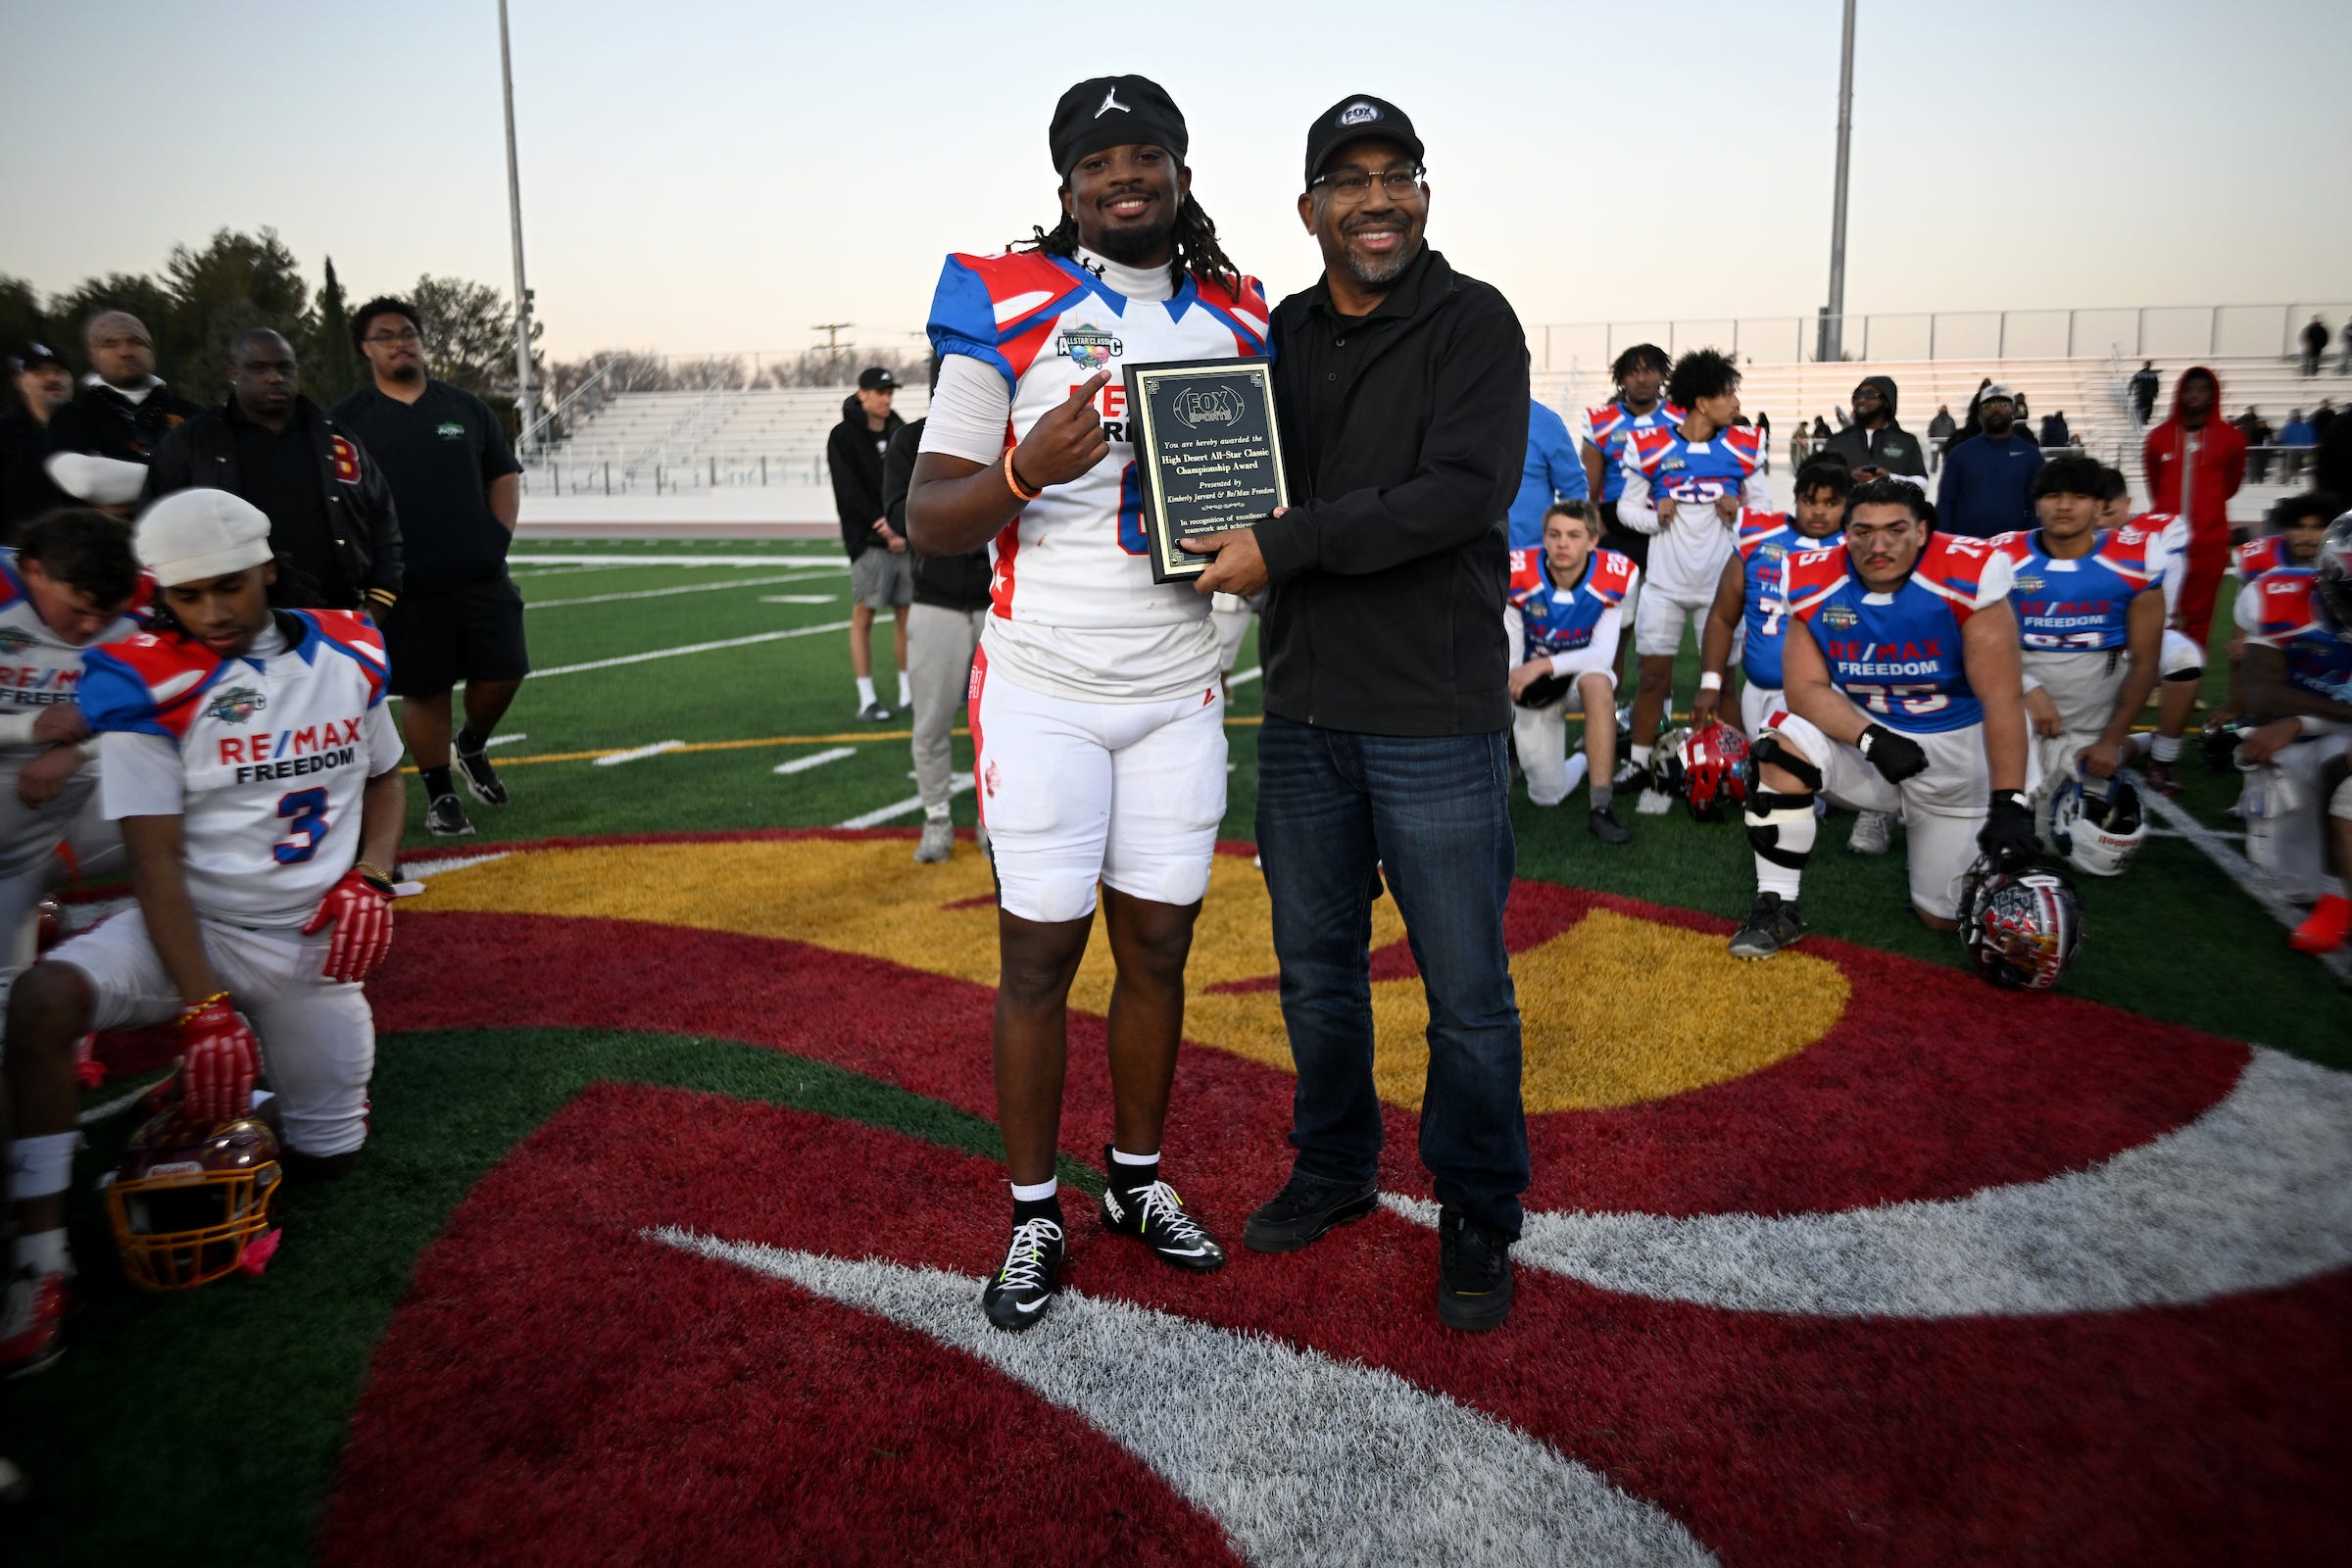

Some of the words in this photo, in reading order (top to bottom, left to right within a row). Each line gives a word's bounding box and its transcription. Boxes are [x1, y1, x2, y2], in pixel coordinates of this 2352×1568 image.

[1345, 108, 1372, 120] FOX
[1187, 391, 1228, 415] FOX
[1189, 410, 1232, 423] SPORTS
[1220, 436, 1250, 445] awarded
[329, 434, 363, 485] B
[1161, 455, 1181, 466] High
[1183, 454, 1208, 463] Desert
[1210, 450, 1242, 461] All-Star
[1244, 448, 1270, 458] Classic
[1176, 463, 1231, 475] Championship
[1233, 461, 1258, 470] Award
[1199, 479, 1231, 489] Presented
[1234, 478, 1242, 487] by
[1167, 494, 1193, 504] Kimberly
[1251, 487, 1276, 496] Freedom
[1190, 515, 1225, 526] recognition
[1185, 525, 1215, 534] teamwork
[2020, 601, 2113, 616] RE/MAX
[2024, 614, 2106, 627] FREEDOM
[1828, 638, 1943, 662] RE/MAX
[1838, 661, 1939, 676] FREEDOM
[0, 665, 82, 690] RE/M
[0, 688, 81, 706] FREE
[1845, 684, 1949, 714] 75
[219, 716, 364, 765] RE/MAX
[236, 747, 356, 784] FREEDOM
[273, 786, 330, 865] 3
[1104, 1187, 1125, 1224] NIKE
